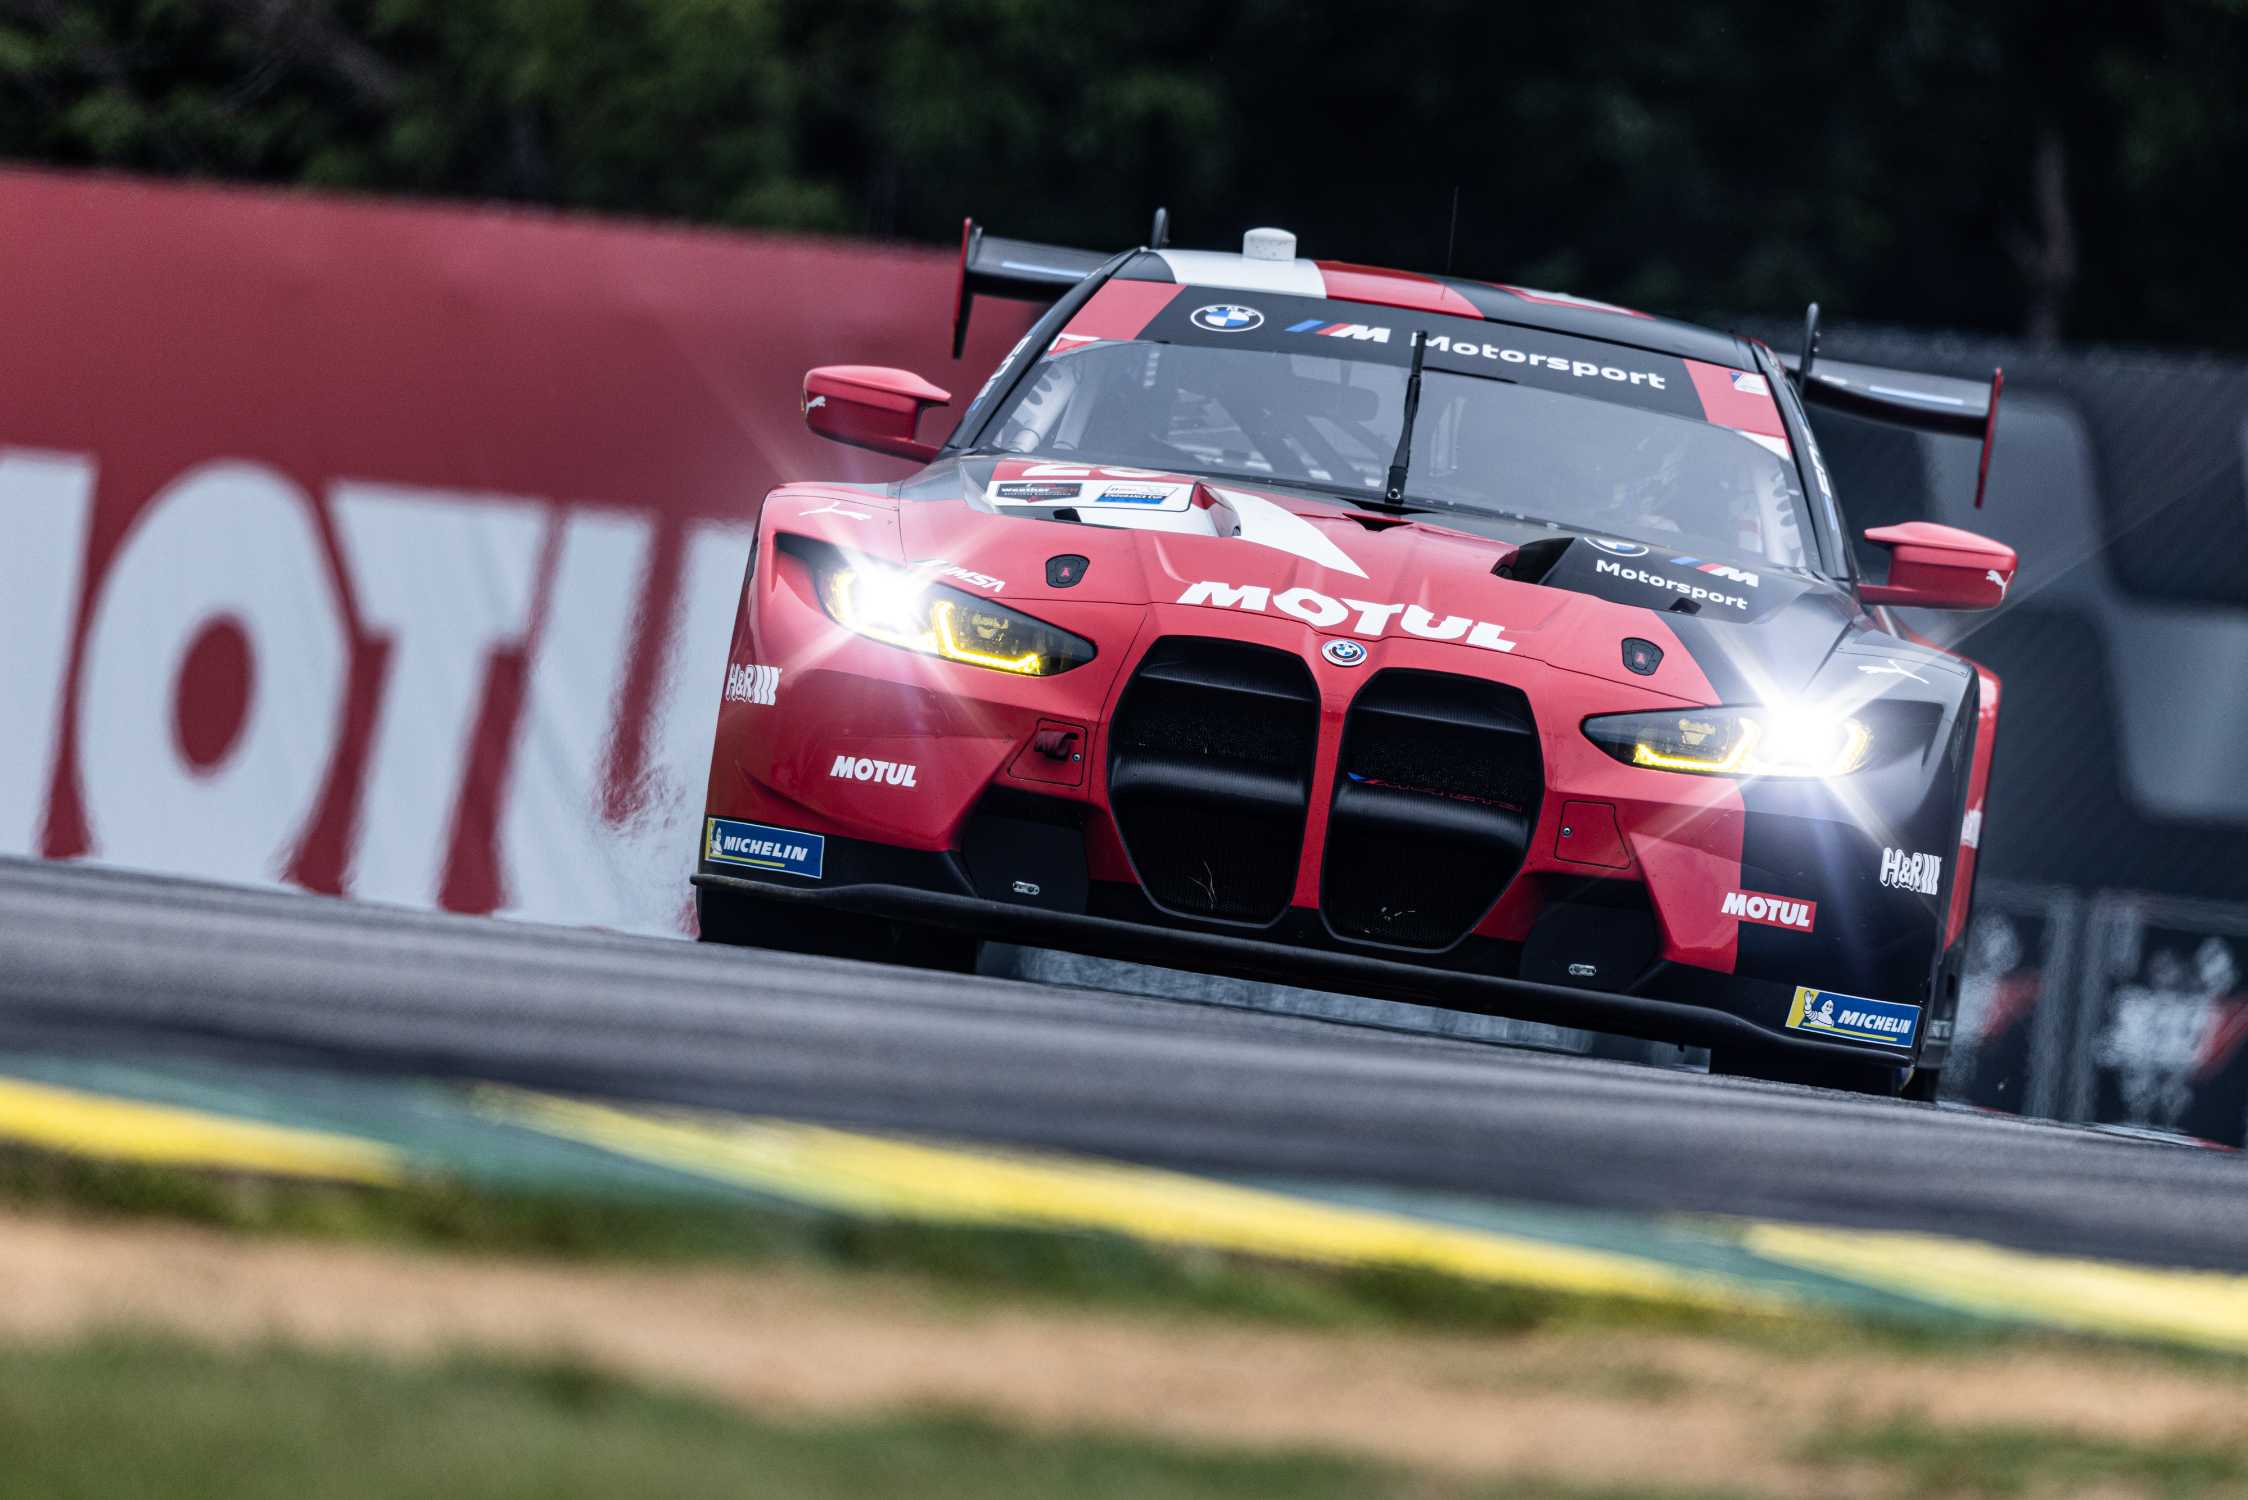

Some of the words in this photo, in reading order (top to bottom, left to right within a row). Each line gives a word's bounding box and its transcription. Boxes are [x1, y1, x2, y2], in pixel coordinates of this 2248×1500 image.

[1410, 331, 1665, 390] Motorsport
[1596, 559, 1748, 610] Motorsport
[1176, 580, 1516, 652] MOTUL
[830, 755, 917, 788] MOTUL
[723, 836, 808, 861] MICHELIN
[1721, 892, 1810, 927] MOTUL
[1838, 1010, 1912, 1034] MICHELIN
